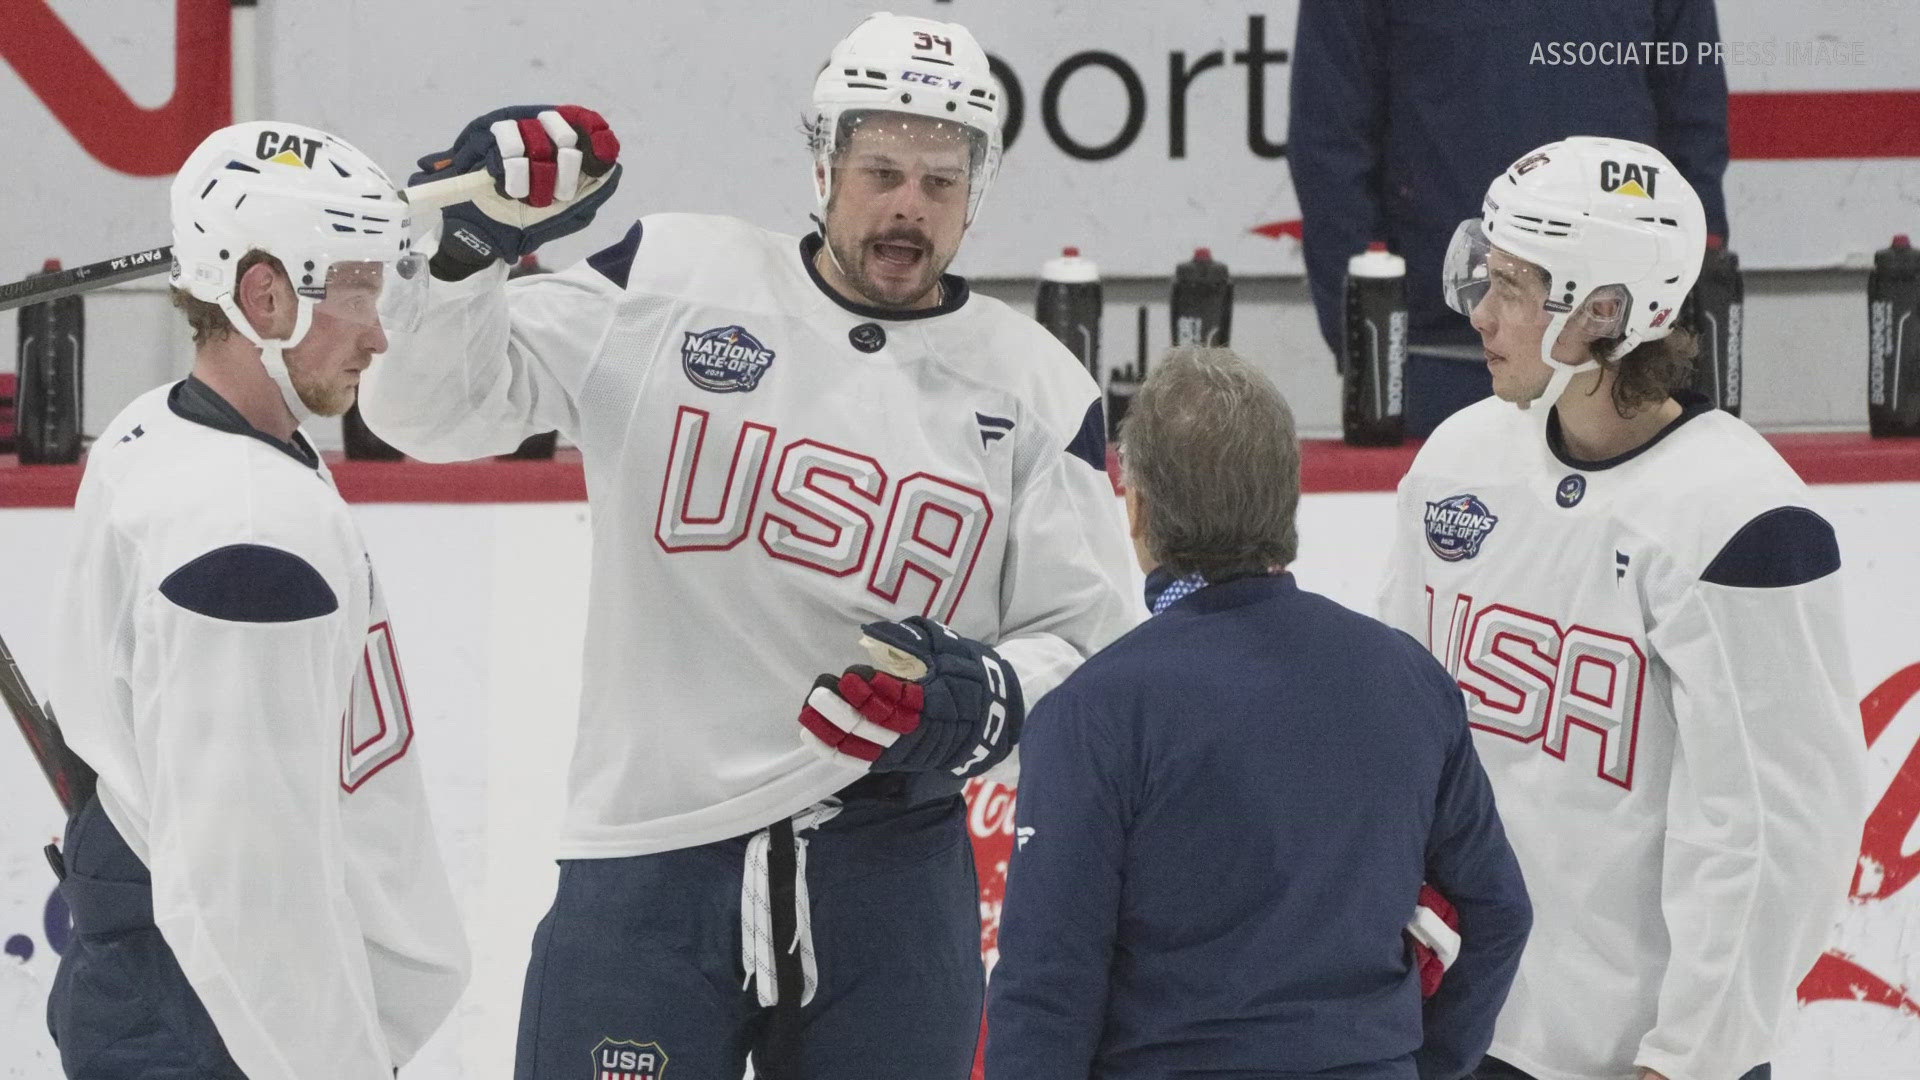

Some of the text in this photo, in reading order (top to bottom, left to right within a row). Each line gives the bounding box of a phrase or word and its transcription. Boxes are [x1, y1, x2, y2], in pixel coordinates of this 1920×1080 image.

[912, 31, 952, 56] 34
[901, 70, 962, 90] CCM
[256, 131, 323, 169] CAT
[1600, 160, 1660, 200] CAT
[111, 250, 162, 270] PAPI 34
[685, 335, 772, 366] NATIONS
[654, 405, 994, 628] USA
[1427, 505, 1495, 531] NATIONS
[602, 1048, 655, 1072] USA
